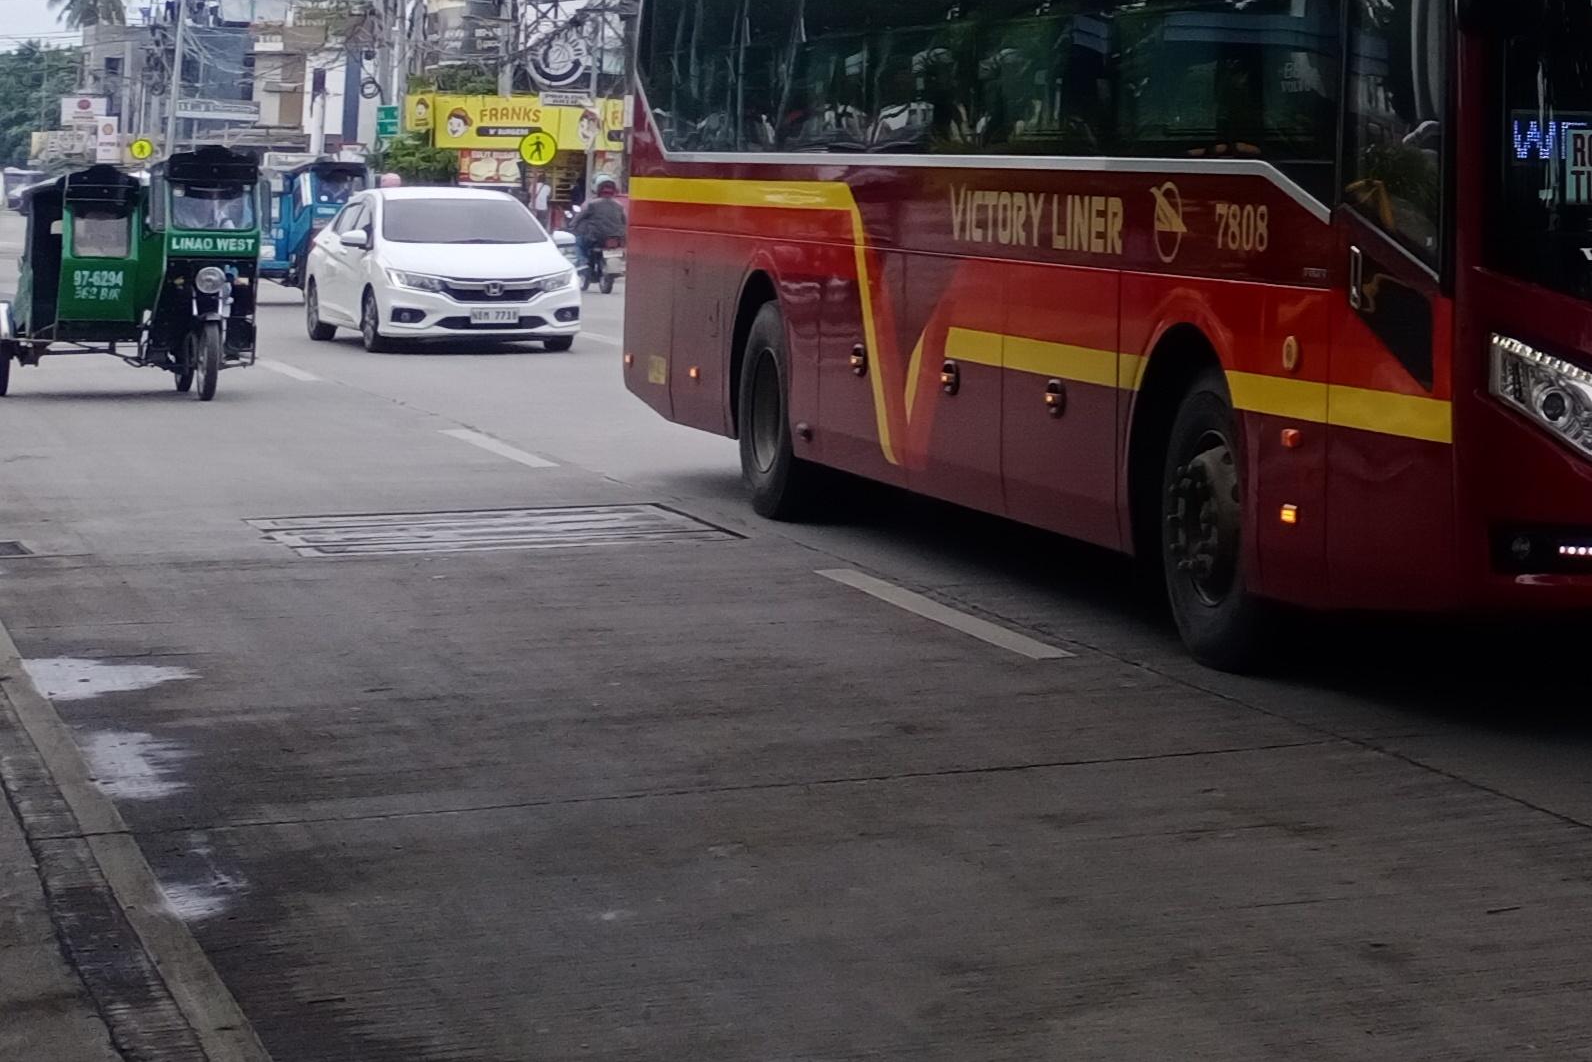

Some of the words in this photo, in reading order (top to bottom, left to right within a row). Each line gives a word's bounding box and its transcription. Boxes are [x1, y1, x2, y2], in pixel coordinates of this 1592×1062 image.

[480, 107, 541, 123] FRANKS
[949, 183, 1046, 248] VICTORY
[1052, 193, 1123, 255] LINER
[1214, 202, 1269, 253] 7808
[171, 237, 213, 251] LINAO
[216, 237, 255, 251] WEST
